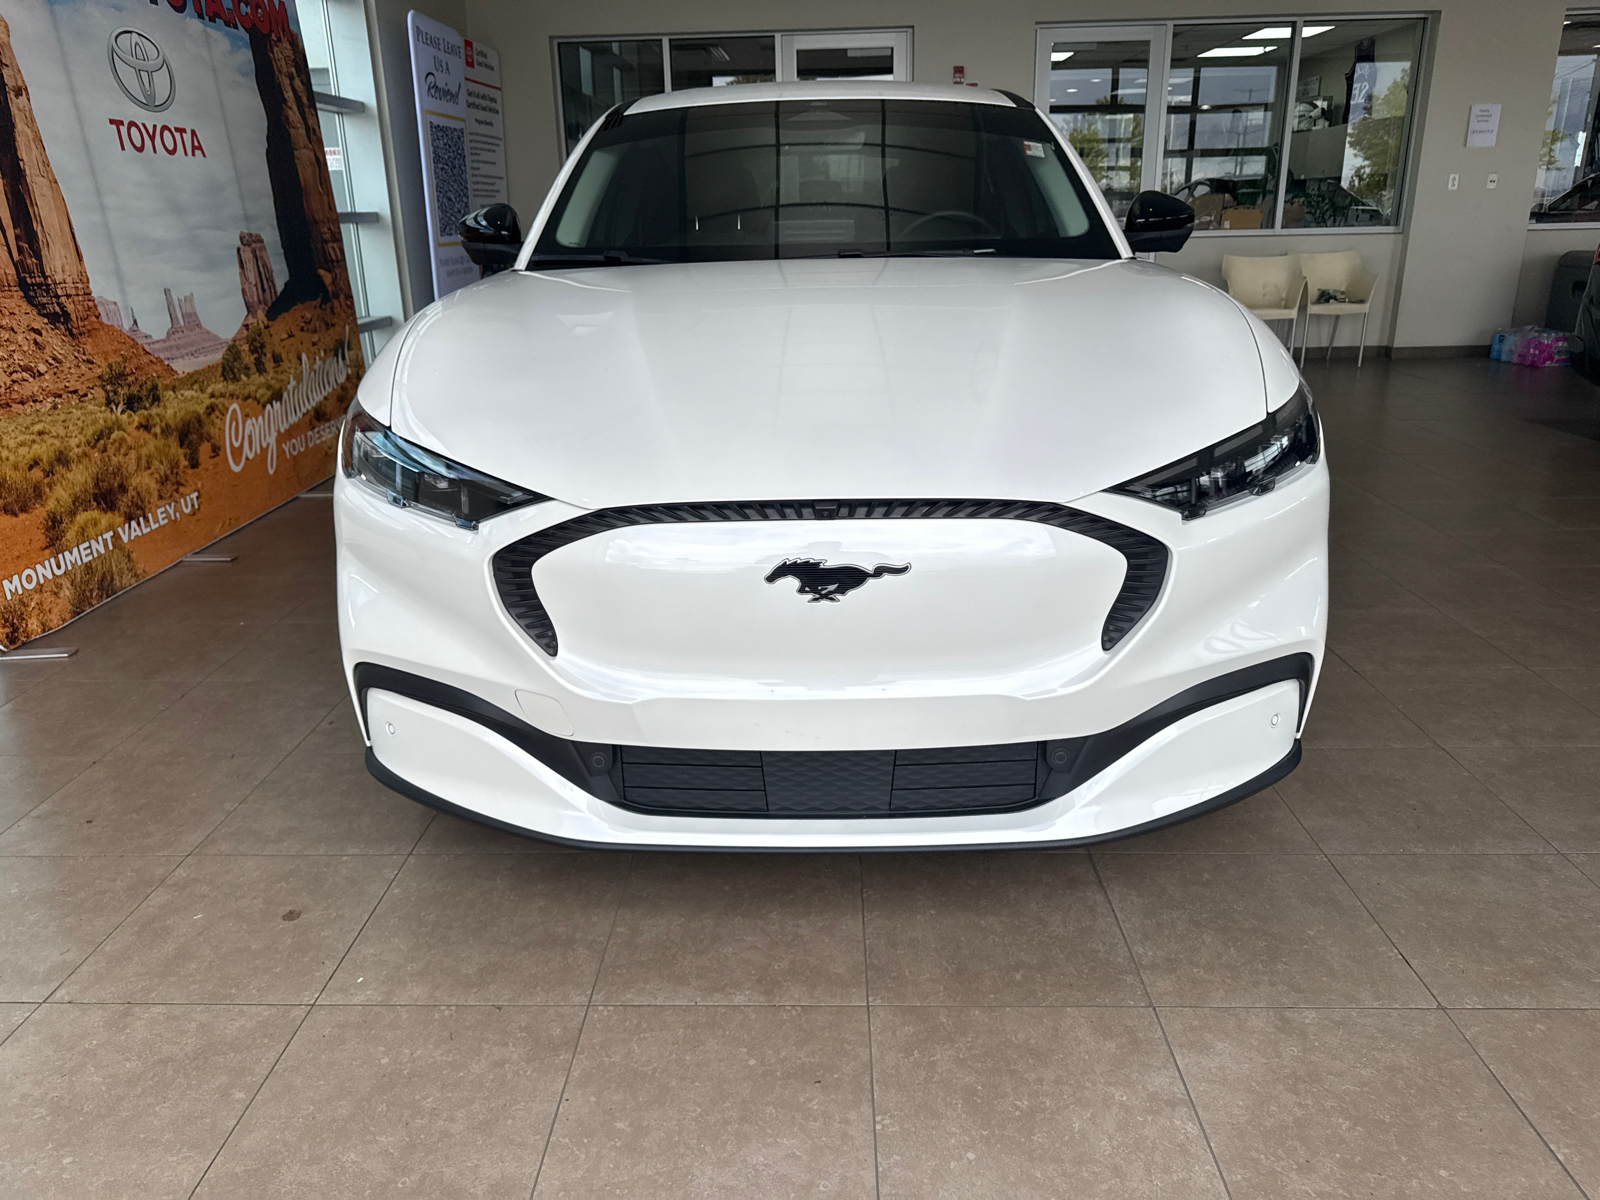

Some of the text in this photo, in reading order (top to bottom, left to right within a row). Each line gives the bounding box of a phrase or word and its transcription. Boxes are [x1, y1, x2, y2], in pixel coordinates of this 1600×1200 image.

[415, 25, 462, 60] PLEASE LEAVE
[433, 55, 451, 76] US A
[424, 71, 462, 106] Review!
[108, 117, 207, 158] TOYOTA
[225, 323, 352, 475] Congratulations!
[281, 434, 306, 459] YOU
[1, 491, 199, 601] MONUMENT VALLEY, UT
